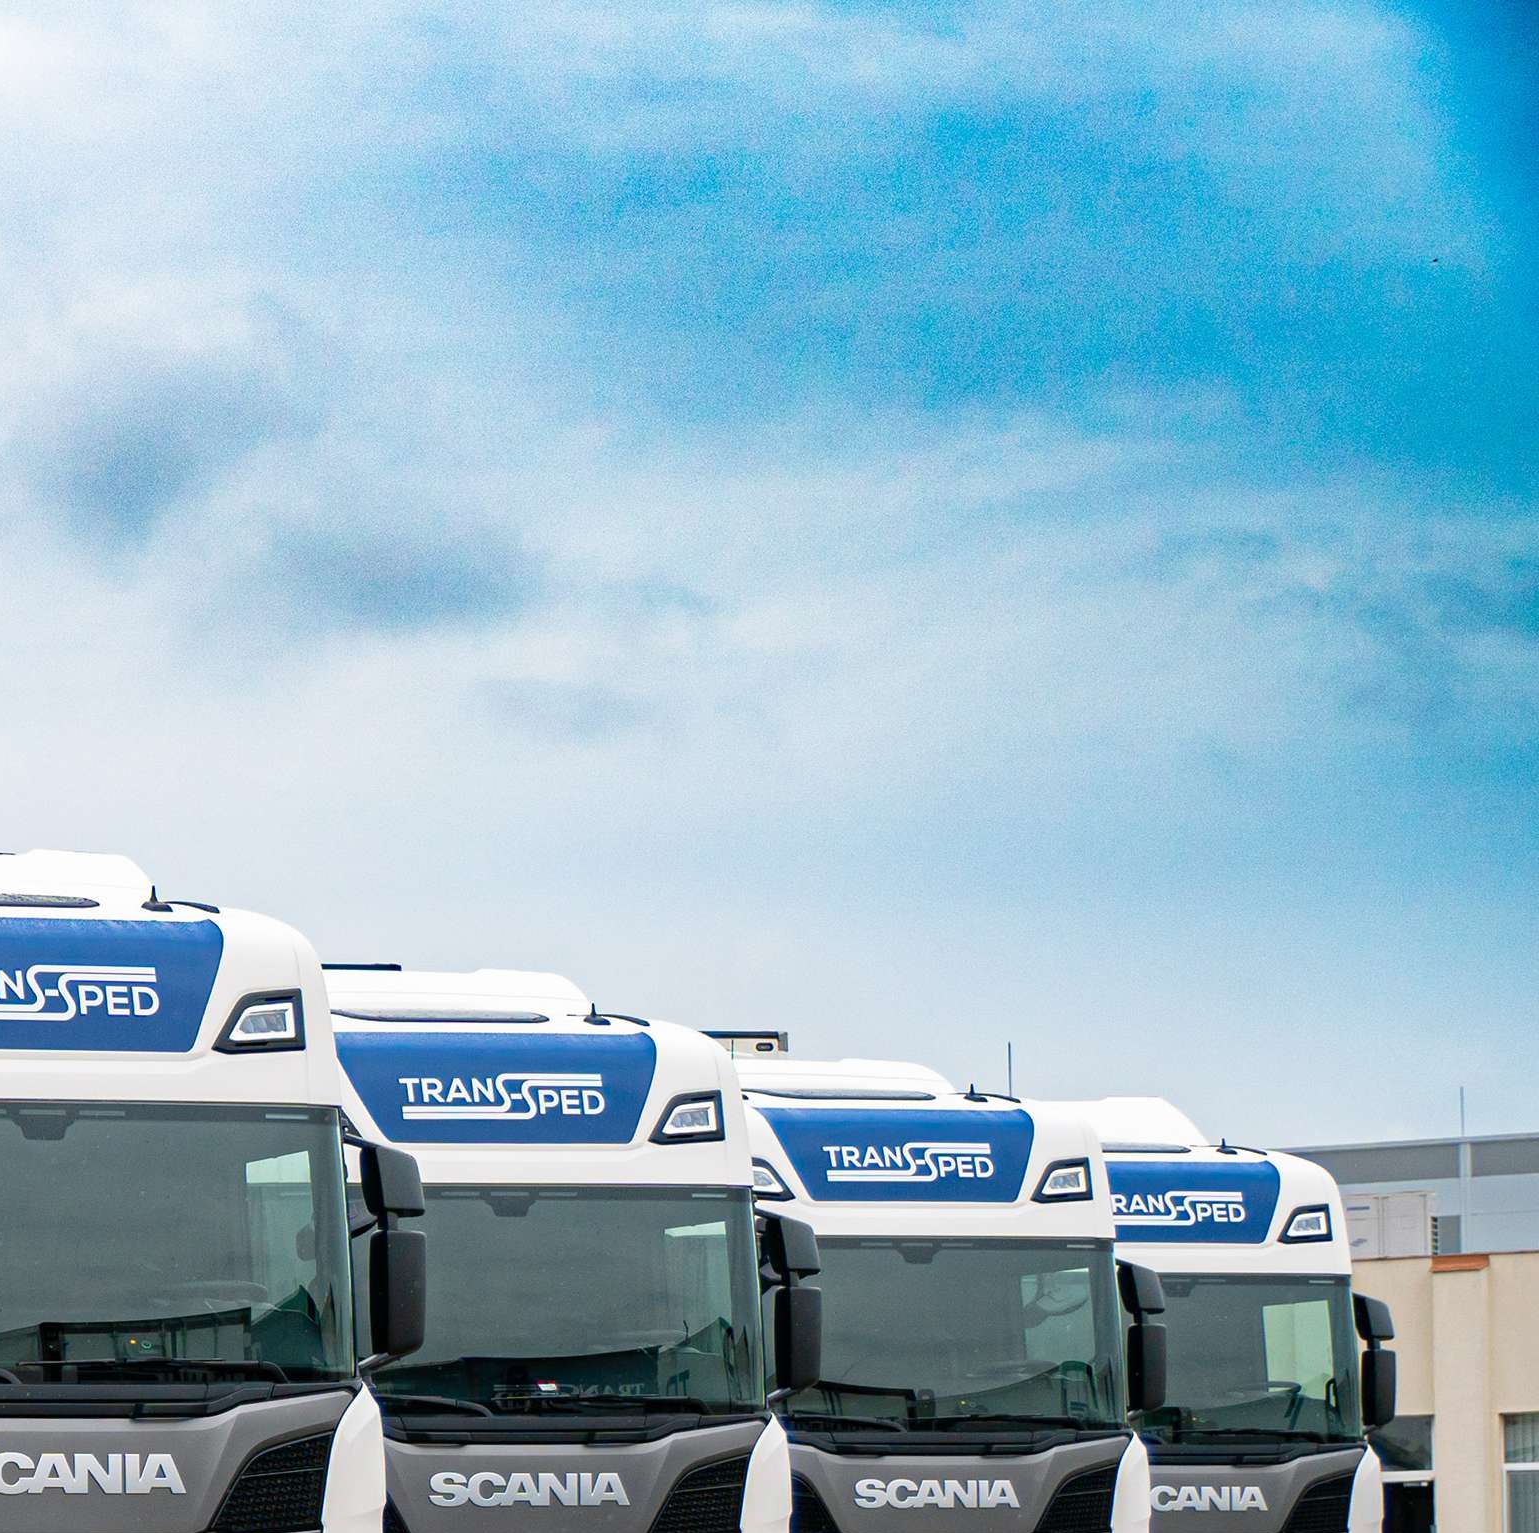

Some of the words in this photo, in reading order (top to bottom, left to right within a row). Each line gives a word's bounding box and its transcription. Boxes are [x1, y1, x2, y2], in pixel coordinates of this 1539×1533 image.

[398, 1072, 605, 1120] TRANS-SPED
[822, 1142, 994, 1182] TRANS-SPED
[1110, 1191, 1246, 1226] RANS-SPED
[428, 1471, 631, 1508] SCANIA
[854, 1478, 1021, 1509] SCANIA
[1150, 1485, 1269, 1511] CANIA
